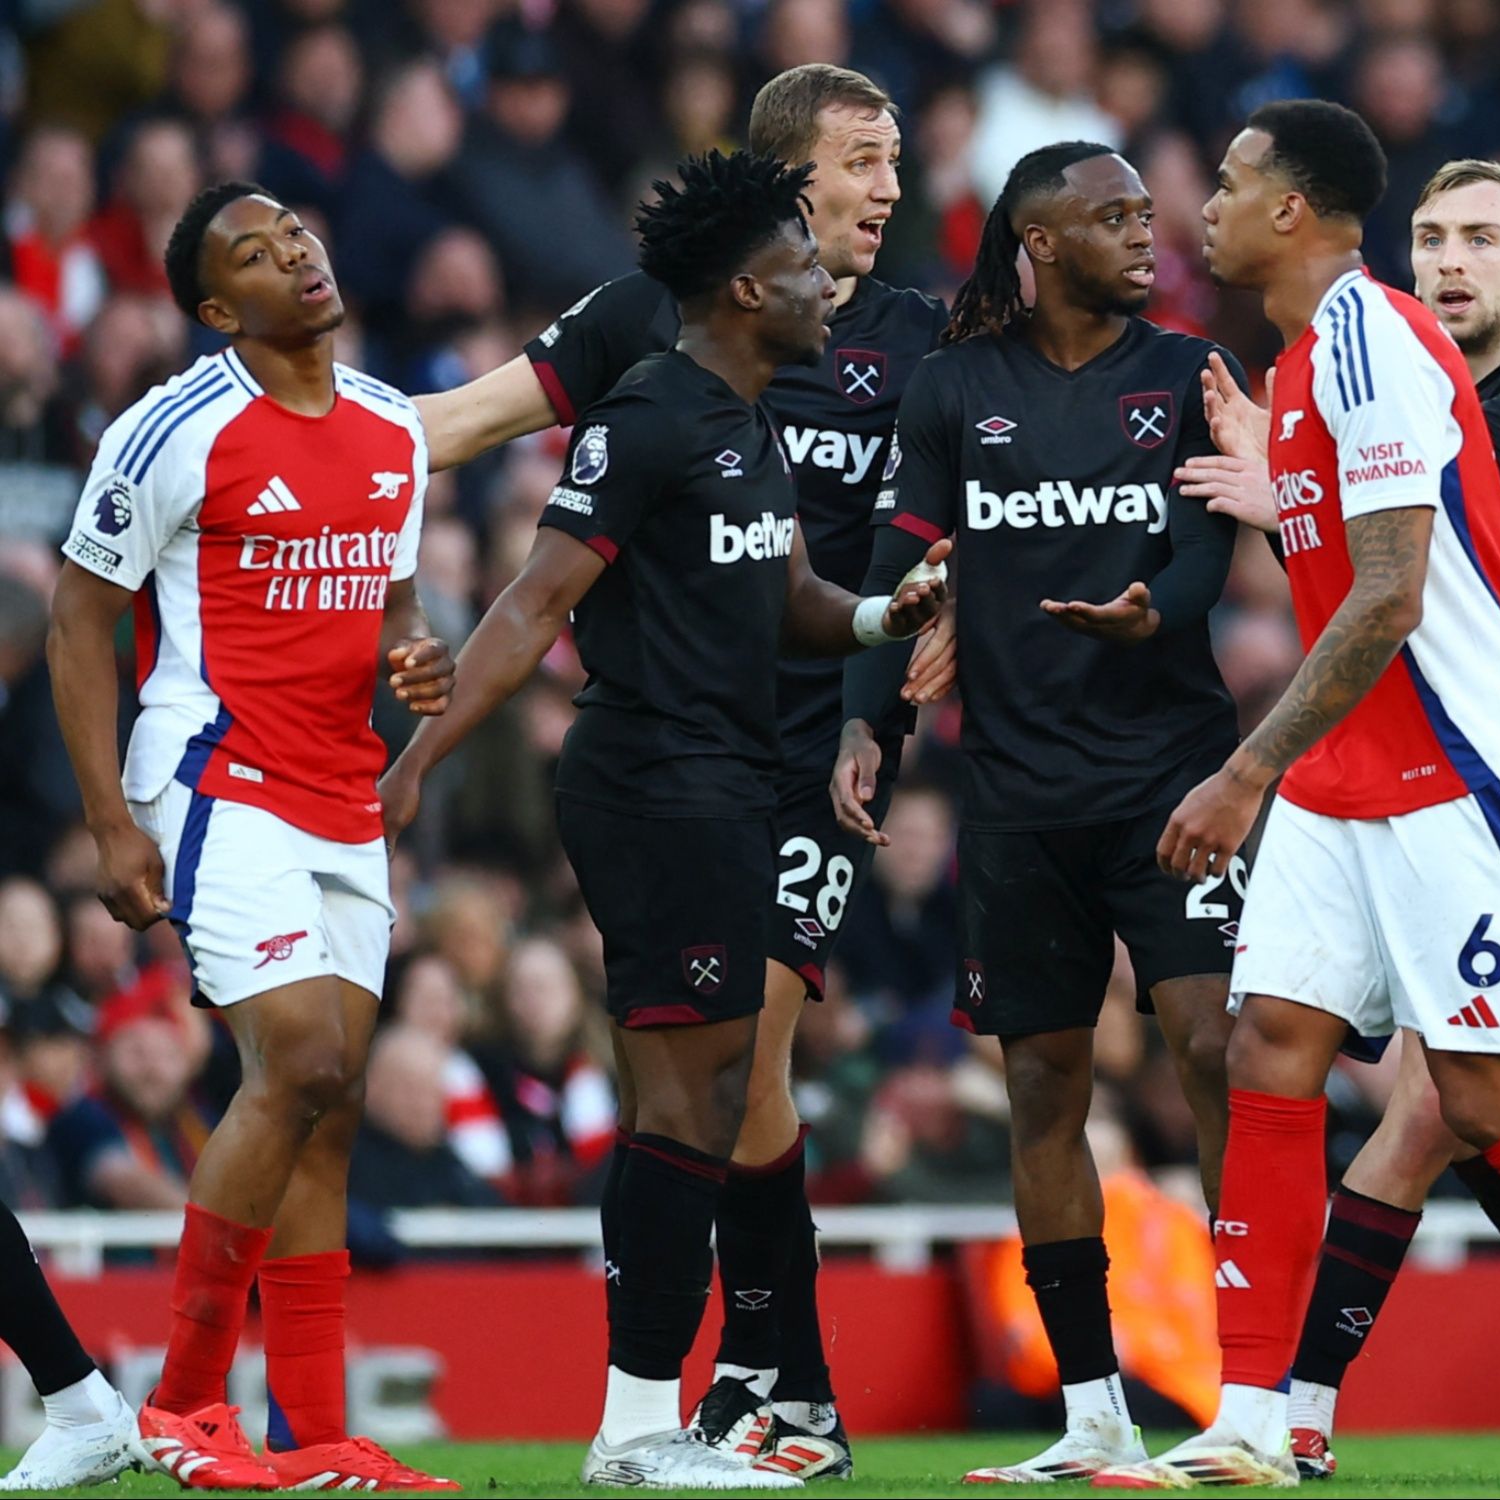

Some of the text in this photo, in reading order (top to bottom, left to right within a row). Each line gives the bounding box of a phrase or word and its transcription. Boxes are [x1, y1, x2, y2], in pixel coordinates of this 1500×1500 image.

[980, 434, 1012, 445] umbro
[1358, 442, 1405, 462] VISIT
[1345, 459, 1427, 487] RWANDA
[965, 480, 1168, 534] betway
[265, 575, 388, 610] FLY BETTER
[776, 836, 854, 931] 28
